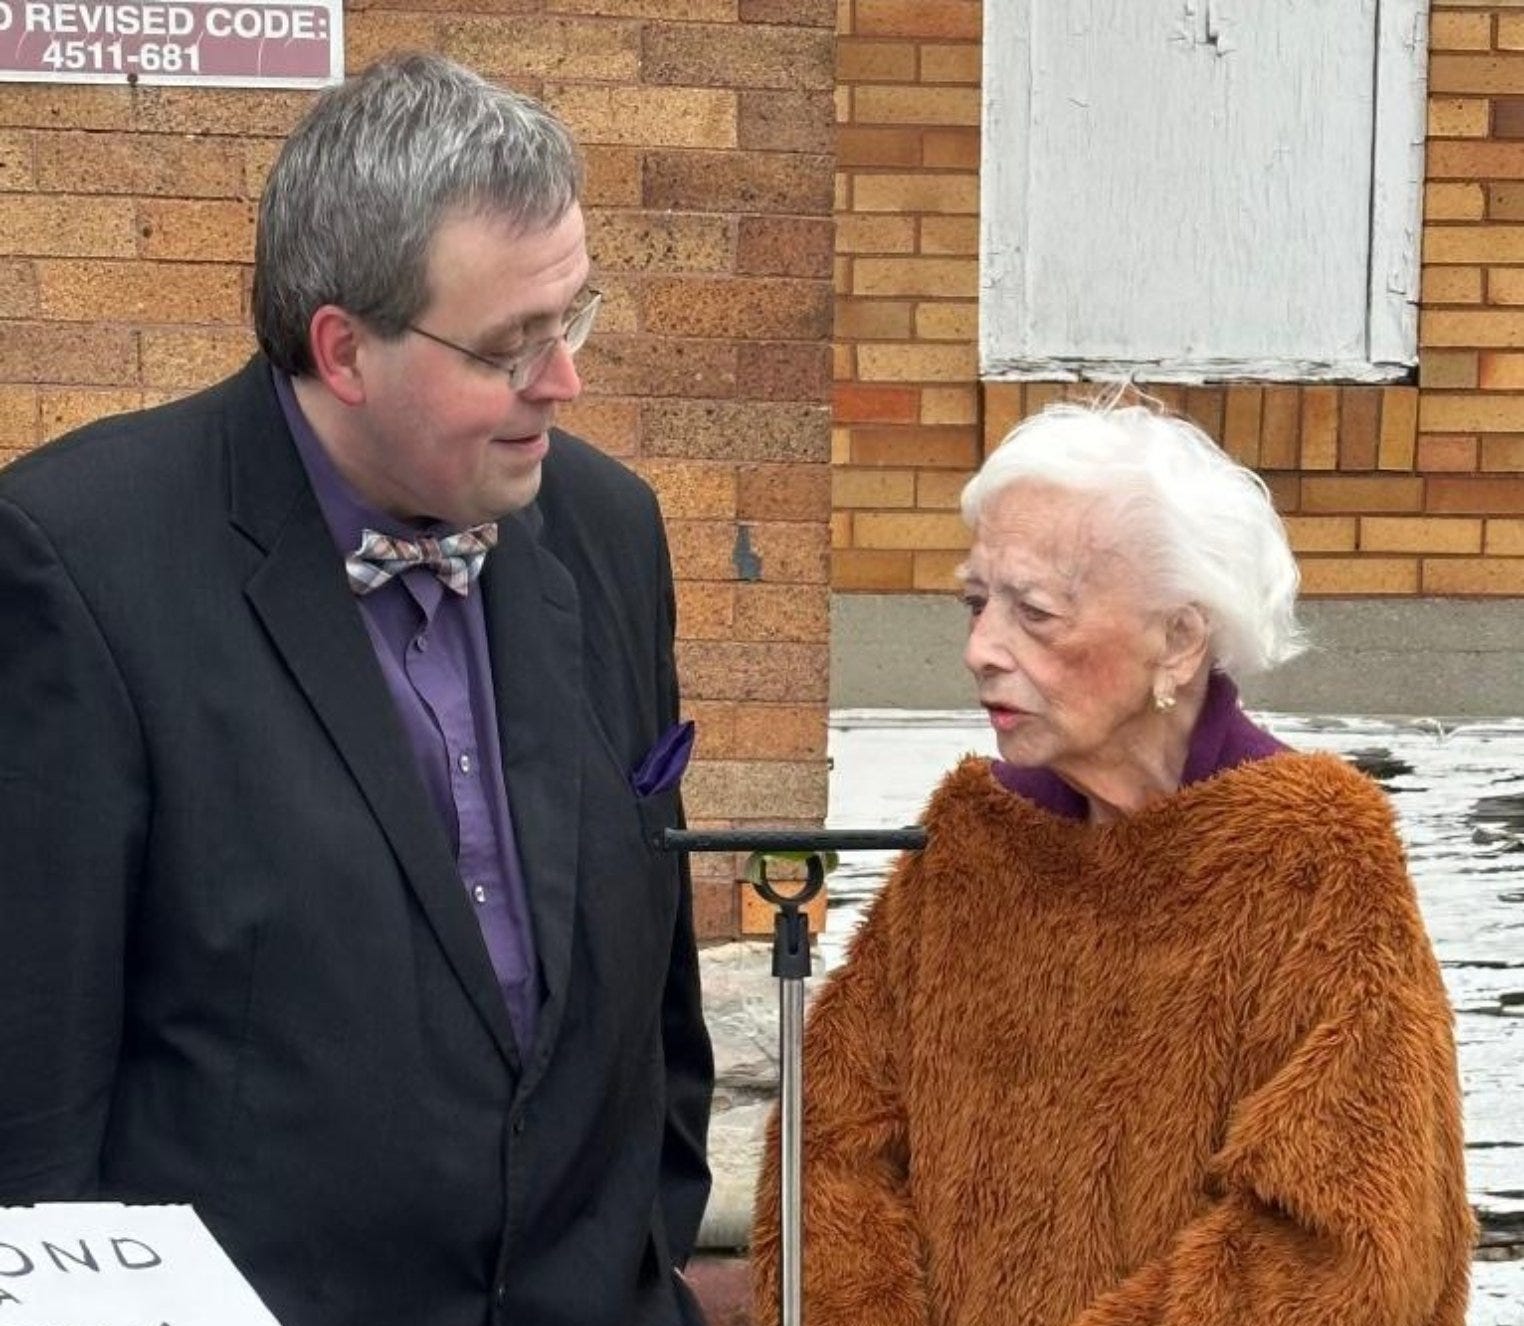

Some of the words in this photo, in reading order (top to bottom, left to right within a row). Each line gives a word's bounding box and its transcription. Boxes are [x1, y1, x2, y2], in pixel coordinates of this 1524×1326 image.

[25, 2, 194, 36] REVISED
[205, 8, 328, 39] CODE:
[42, 41, 200, 71] 4511-681
